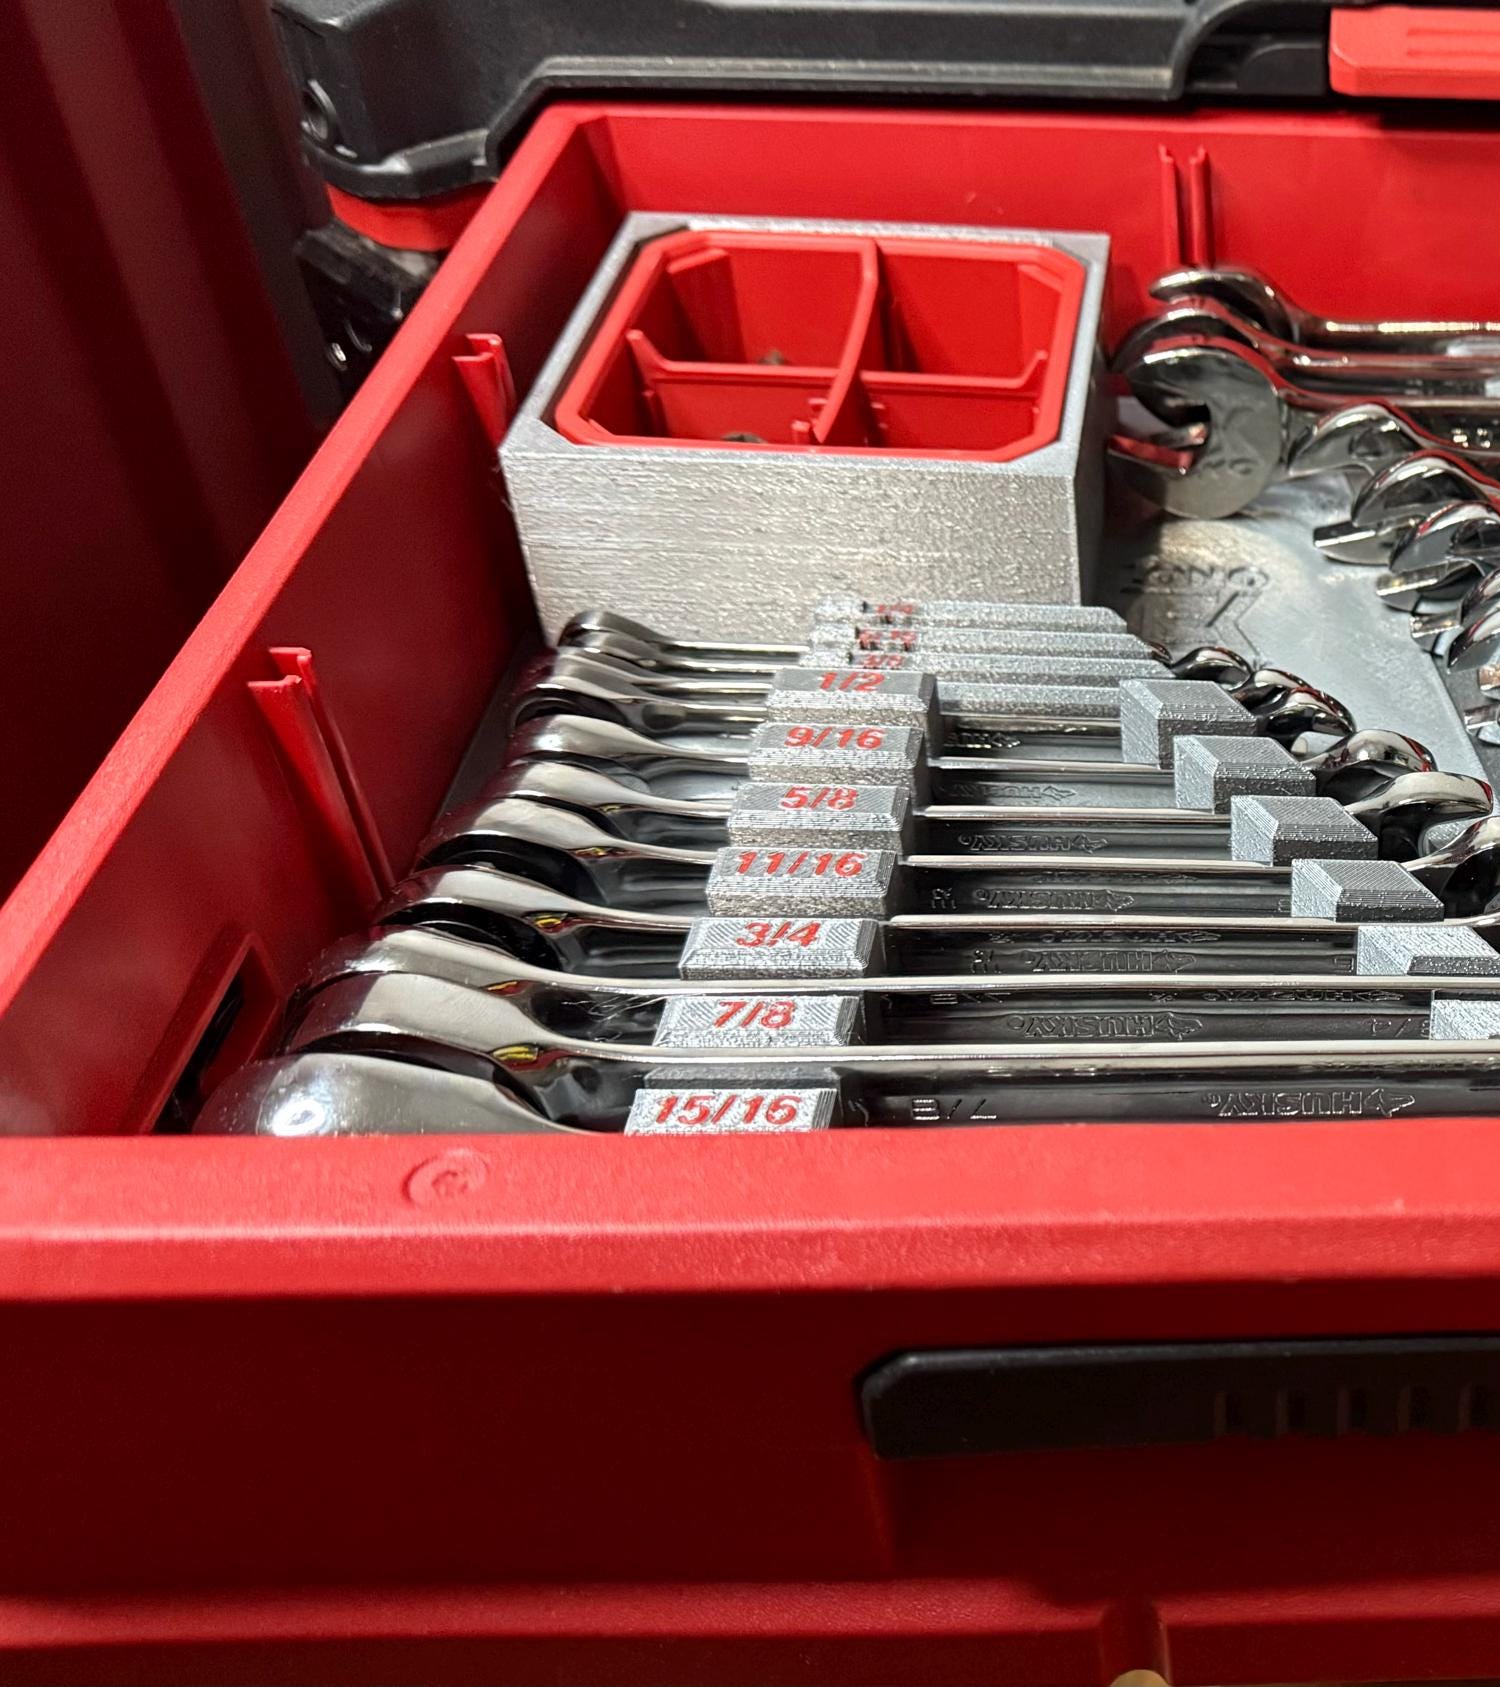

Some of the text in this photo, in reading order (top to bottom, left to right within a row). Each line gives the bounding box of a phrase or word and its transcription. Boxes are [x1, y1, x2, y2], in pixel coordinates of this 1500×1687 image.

[818, 671, 885, 693] 1/2
[783, 726, 885, 750] 9/16
[780, 786, 858, 811] 5/8
[736, 850, 866, 878] 11/16
[735, 921, 820, 948] 3/4
[713, 999, 796, 1030] 7/8
[1023, 1014, 1157, 1039] HUSKY
[654, 1094, 803, 1127] 15/16
[1217, 1090, 1364, 1118] HUSKY
